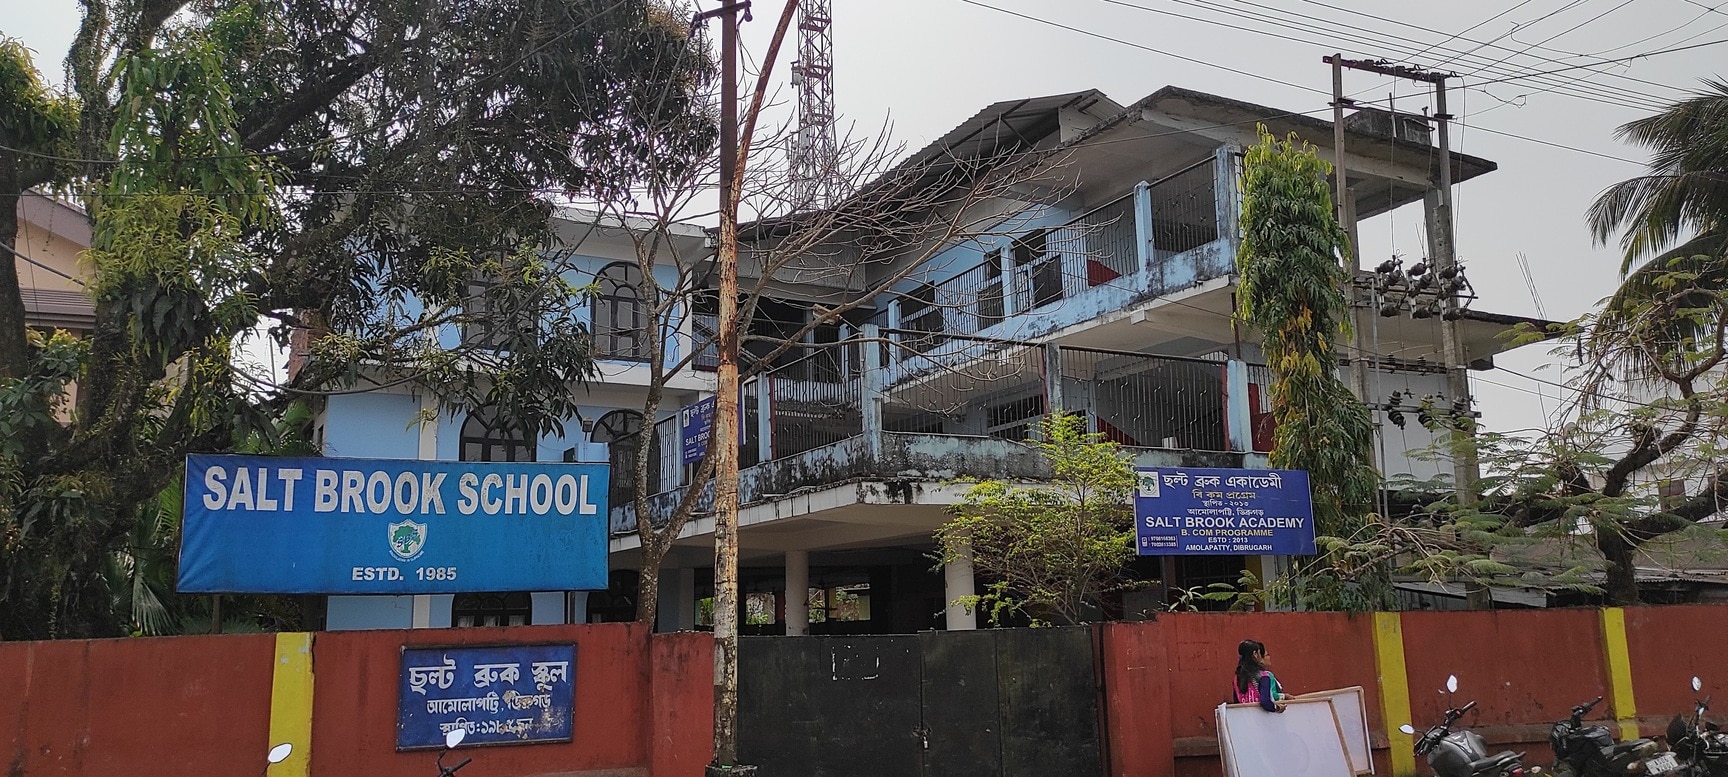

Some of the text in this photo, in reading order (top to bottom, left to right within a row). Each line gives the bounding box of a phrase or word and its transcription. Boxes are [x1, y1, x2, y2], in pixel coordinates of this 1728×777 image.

[685, 435, 698, 446] SALT
[1225, 472, 1282, 489] একাডেমী
[202, 465, 597, 516] SALT BROOK SCHOOL
[1145, 516, 1304, 529] SALT BROOK ACADEMY
[1185, 544, 1233, 552] AMOLAPATTY,
[351, 566, 458, 582] ESTD. 1985
[408, 654, 457, 695] ছল্ট
[531, 661, 569, 691] স্কুল
